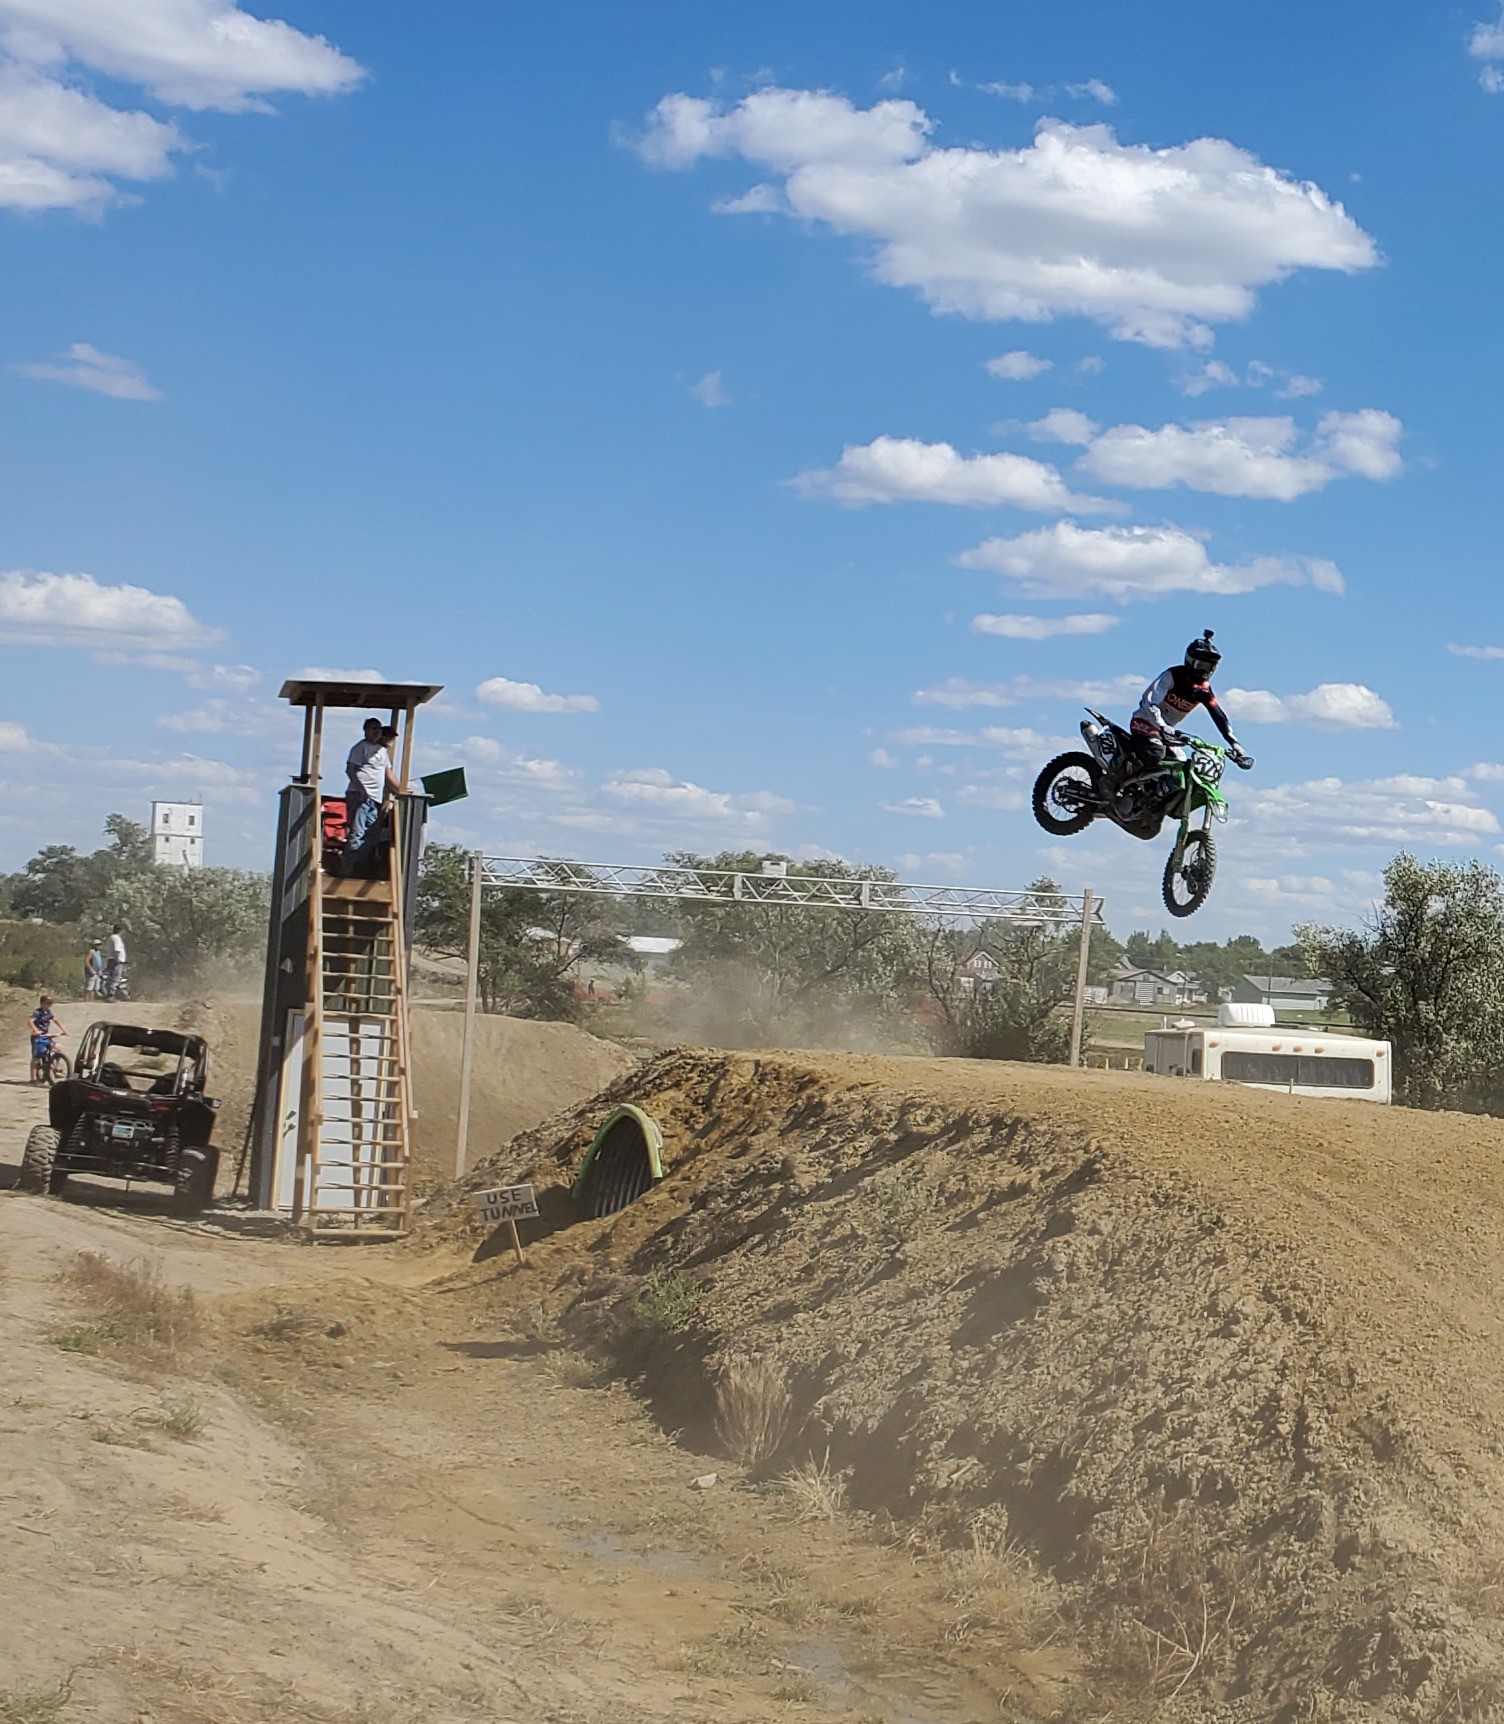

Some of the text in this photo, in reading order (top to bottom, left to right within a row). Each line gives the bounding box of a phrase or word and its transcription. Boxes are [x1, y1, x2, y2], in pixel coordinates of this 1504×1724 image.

[1193, 756, 1223, 781] 528
[486, 1188, 521, 1205] USE
[480, 1202, 537, 1221] TUNNEL
